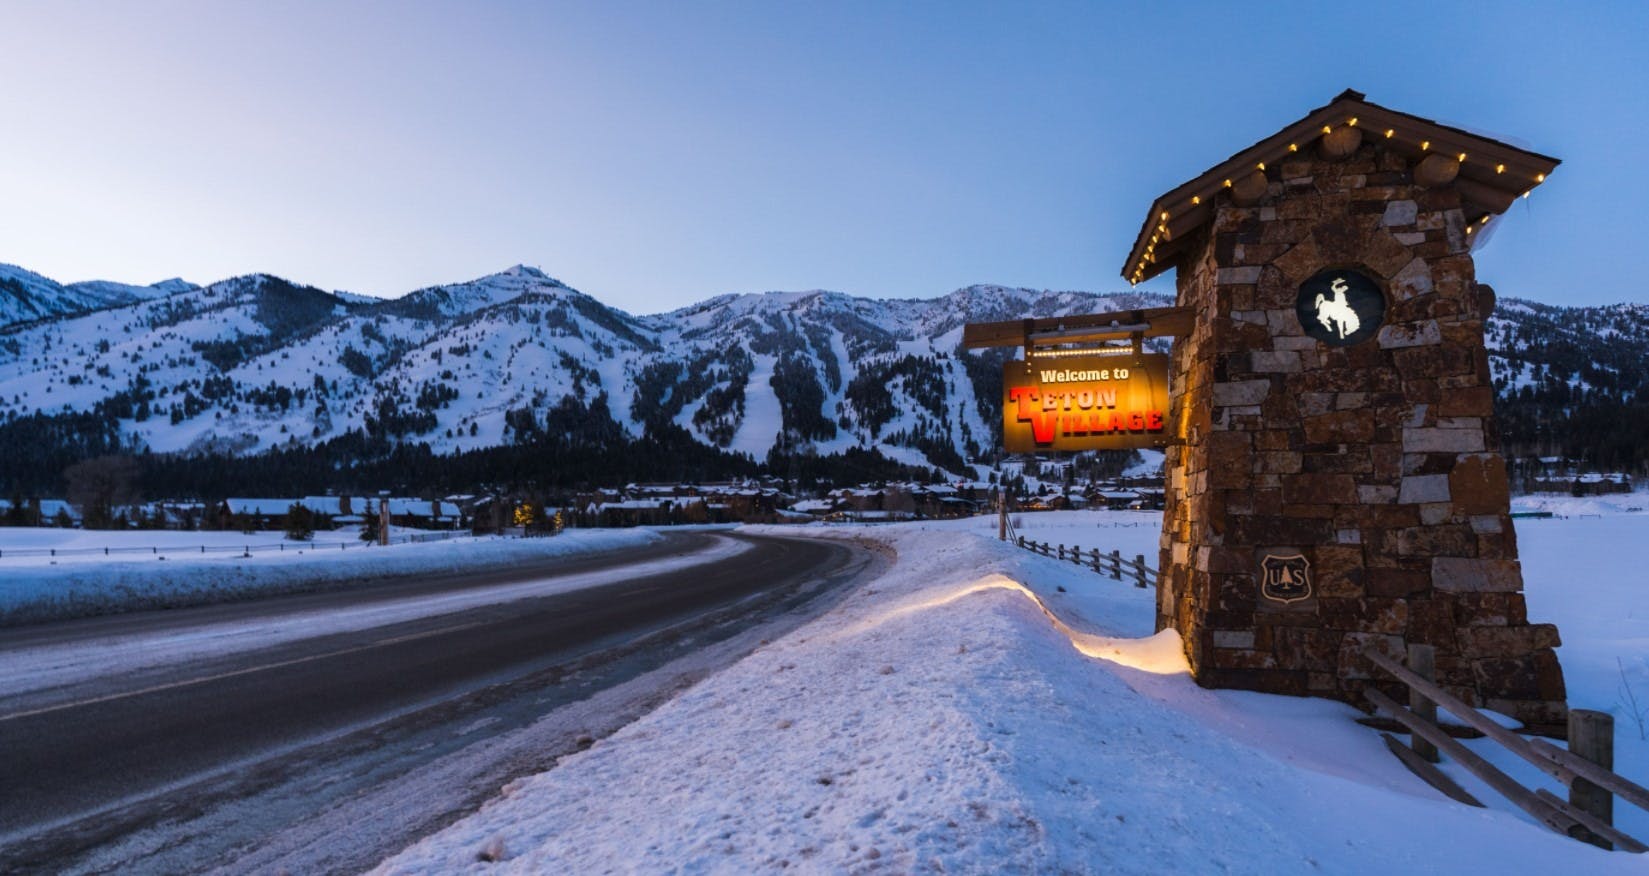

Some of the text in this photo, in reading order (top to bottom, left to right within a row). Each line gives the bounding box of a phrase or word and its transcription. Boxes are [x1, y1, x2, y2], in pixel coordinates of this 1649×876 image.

[1041, 368, 1129, 382] Welcome to
[1009, 386, 1117, 421] TETON
[1031, 409, 1163, 444] VILLAGE
